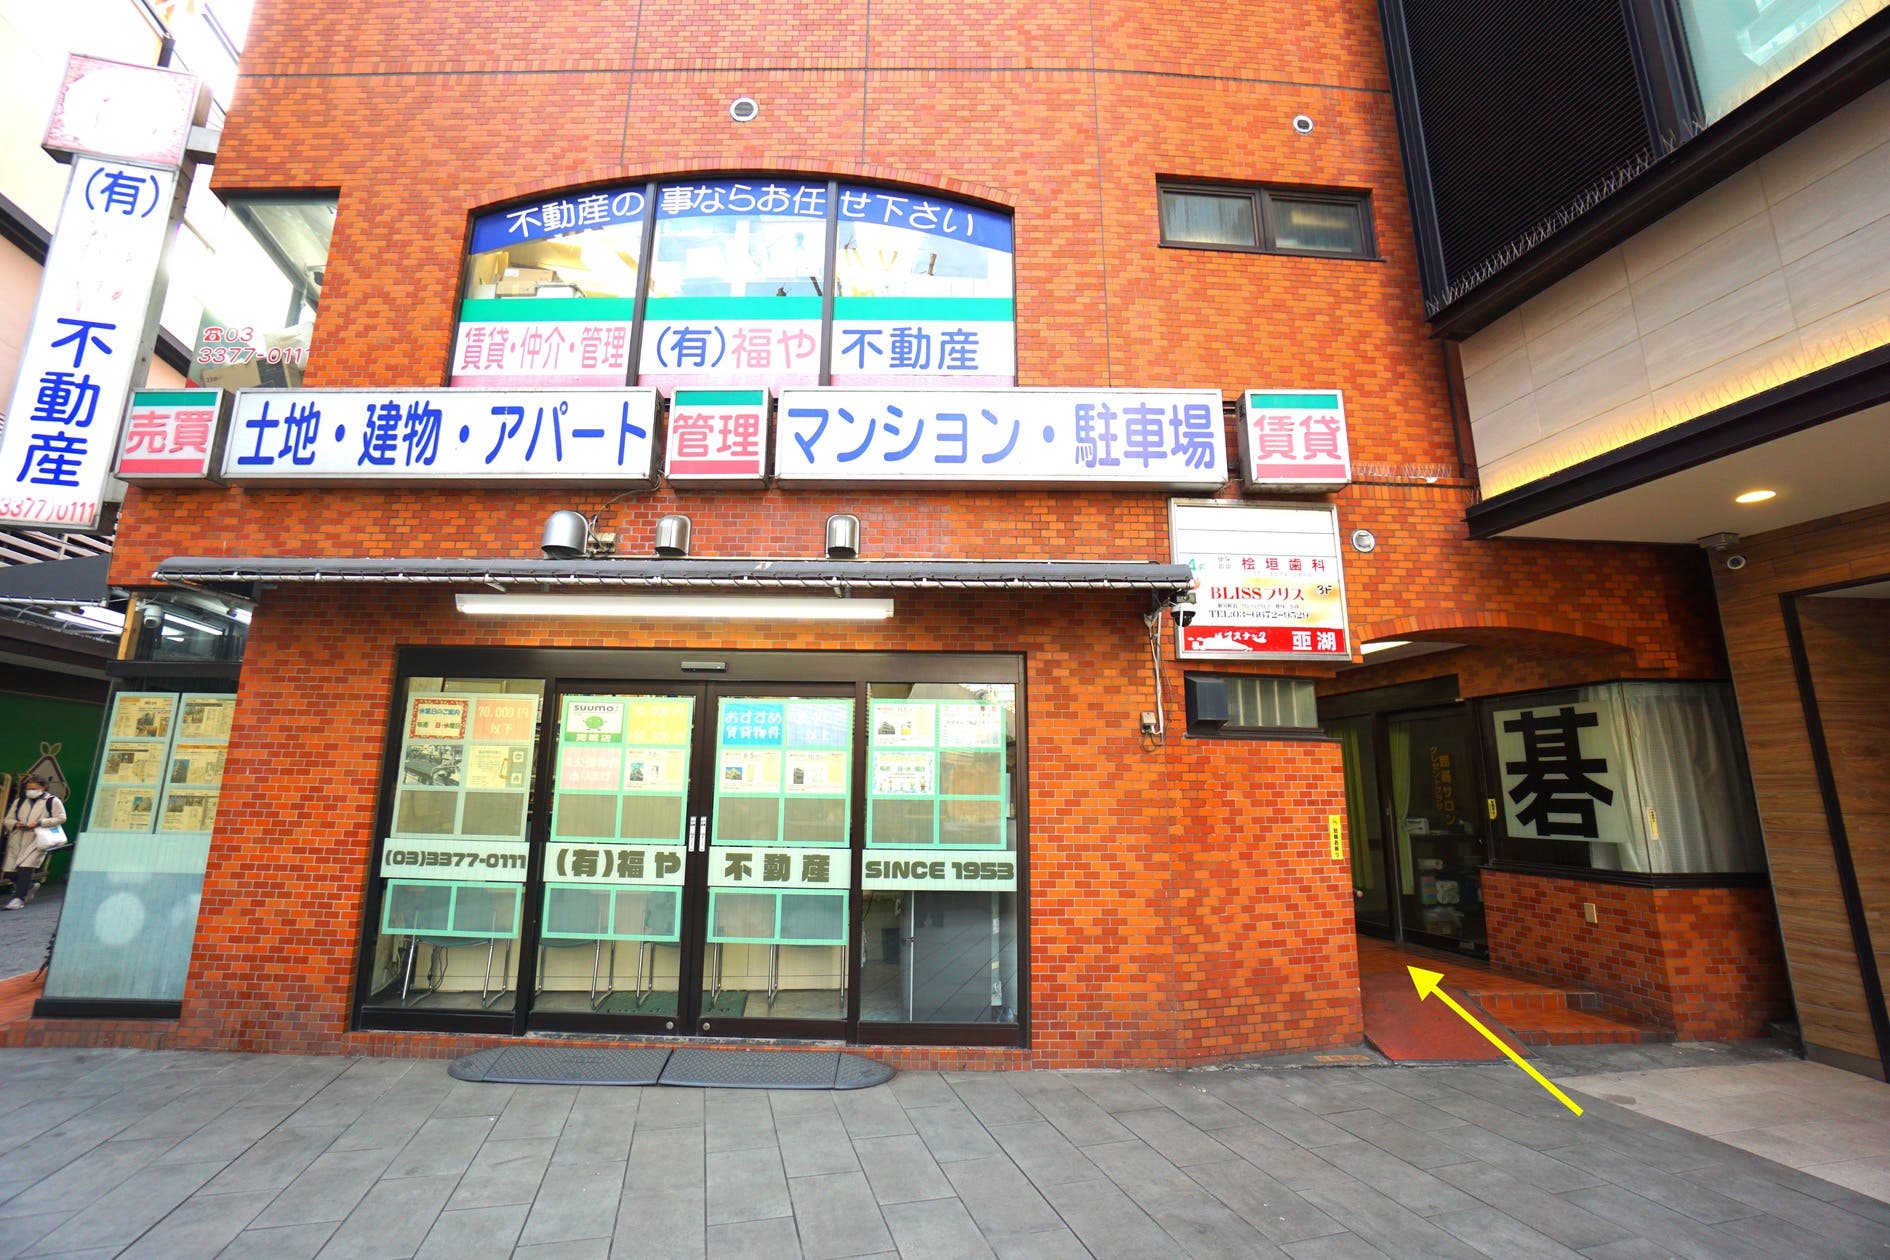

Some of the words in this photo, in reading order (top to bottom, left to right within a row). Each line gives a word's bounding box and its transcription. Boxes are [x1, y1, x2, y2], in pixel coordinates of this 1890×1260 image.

[86, 167, 160, 218] (有)
[224, 326, 254, 342] 03
[841, 326, 979, 370] 不動産
[16, 318, 117, 487] 不動産
[125, 410, 214, 454] 売買
[237, 400, 647, 466] 土地・建物・アパート
[673, 412, 759, 457] 管理
[1253, 414, 1342, 460] 賃貸
[1242, 557, 1325, 572] 桧垣歯科
[1291, 631, 1337, 651] 亜湖
[1503, 706, 1614, 838] 碁
[384, 849, 526, 869] (03)3377-0111
[724, 852, 831, 883] 不動産
[865, 860, 945, 880] SINCE
[951, 861, 1015, 880] 1953
